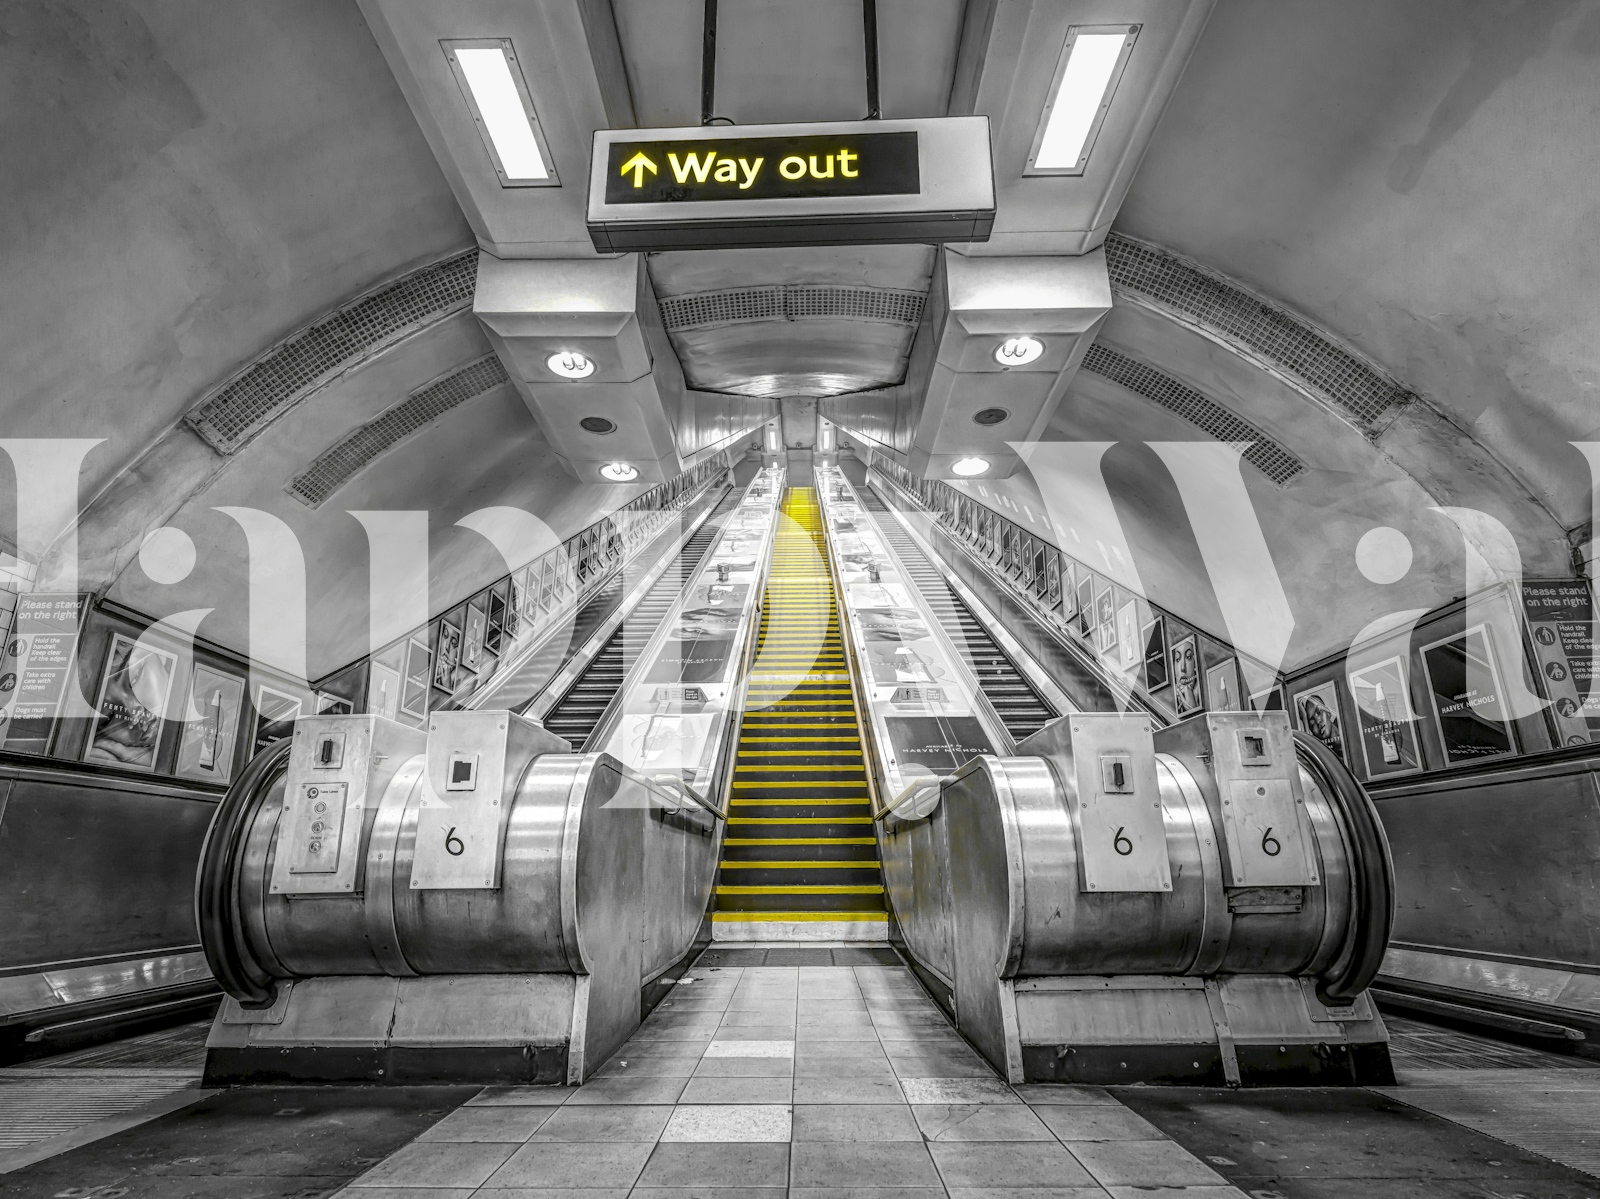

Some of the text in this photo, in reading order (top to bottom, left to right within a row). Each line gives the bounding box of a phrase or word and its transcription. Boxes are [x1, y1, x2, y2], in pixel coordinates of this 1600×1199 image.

[668, 149, 859, 190] Way out
[1522, 586, 1588, 596] Please stand
[21, 600, 83, 609] Please stand
[1526, 596, 1589, 608] on the right
[33, 610, 51, 619] the
[52, 610, 77, 621] right
[1562, 637, 1579, 645] Keep
[31, 649, 46, 657] Keep
[51, 655, 67, 663] edges
[103, 702, 128, 713] FENTY
[1441, 694, 1496, 714] HARVEY NICHOLS
[15, 706, 31, 714] Dogs
[1364, 724, 1382, 734] FENTY
[445, 826, 465, 856] 6
[1113, 826, 1133, 856] 6
[1261, 827, 1281, 856] 6
